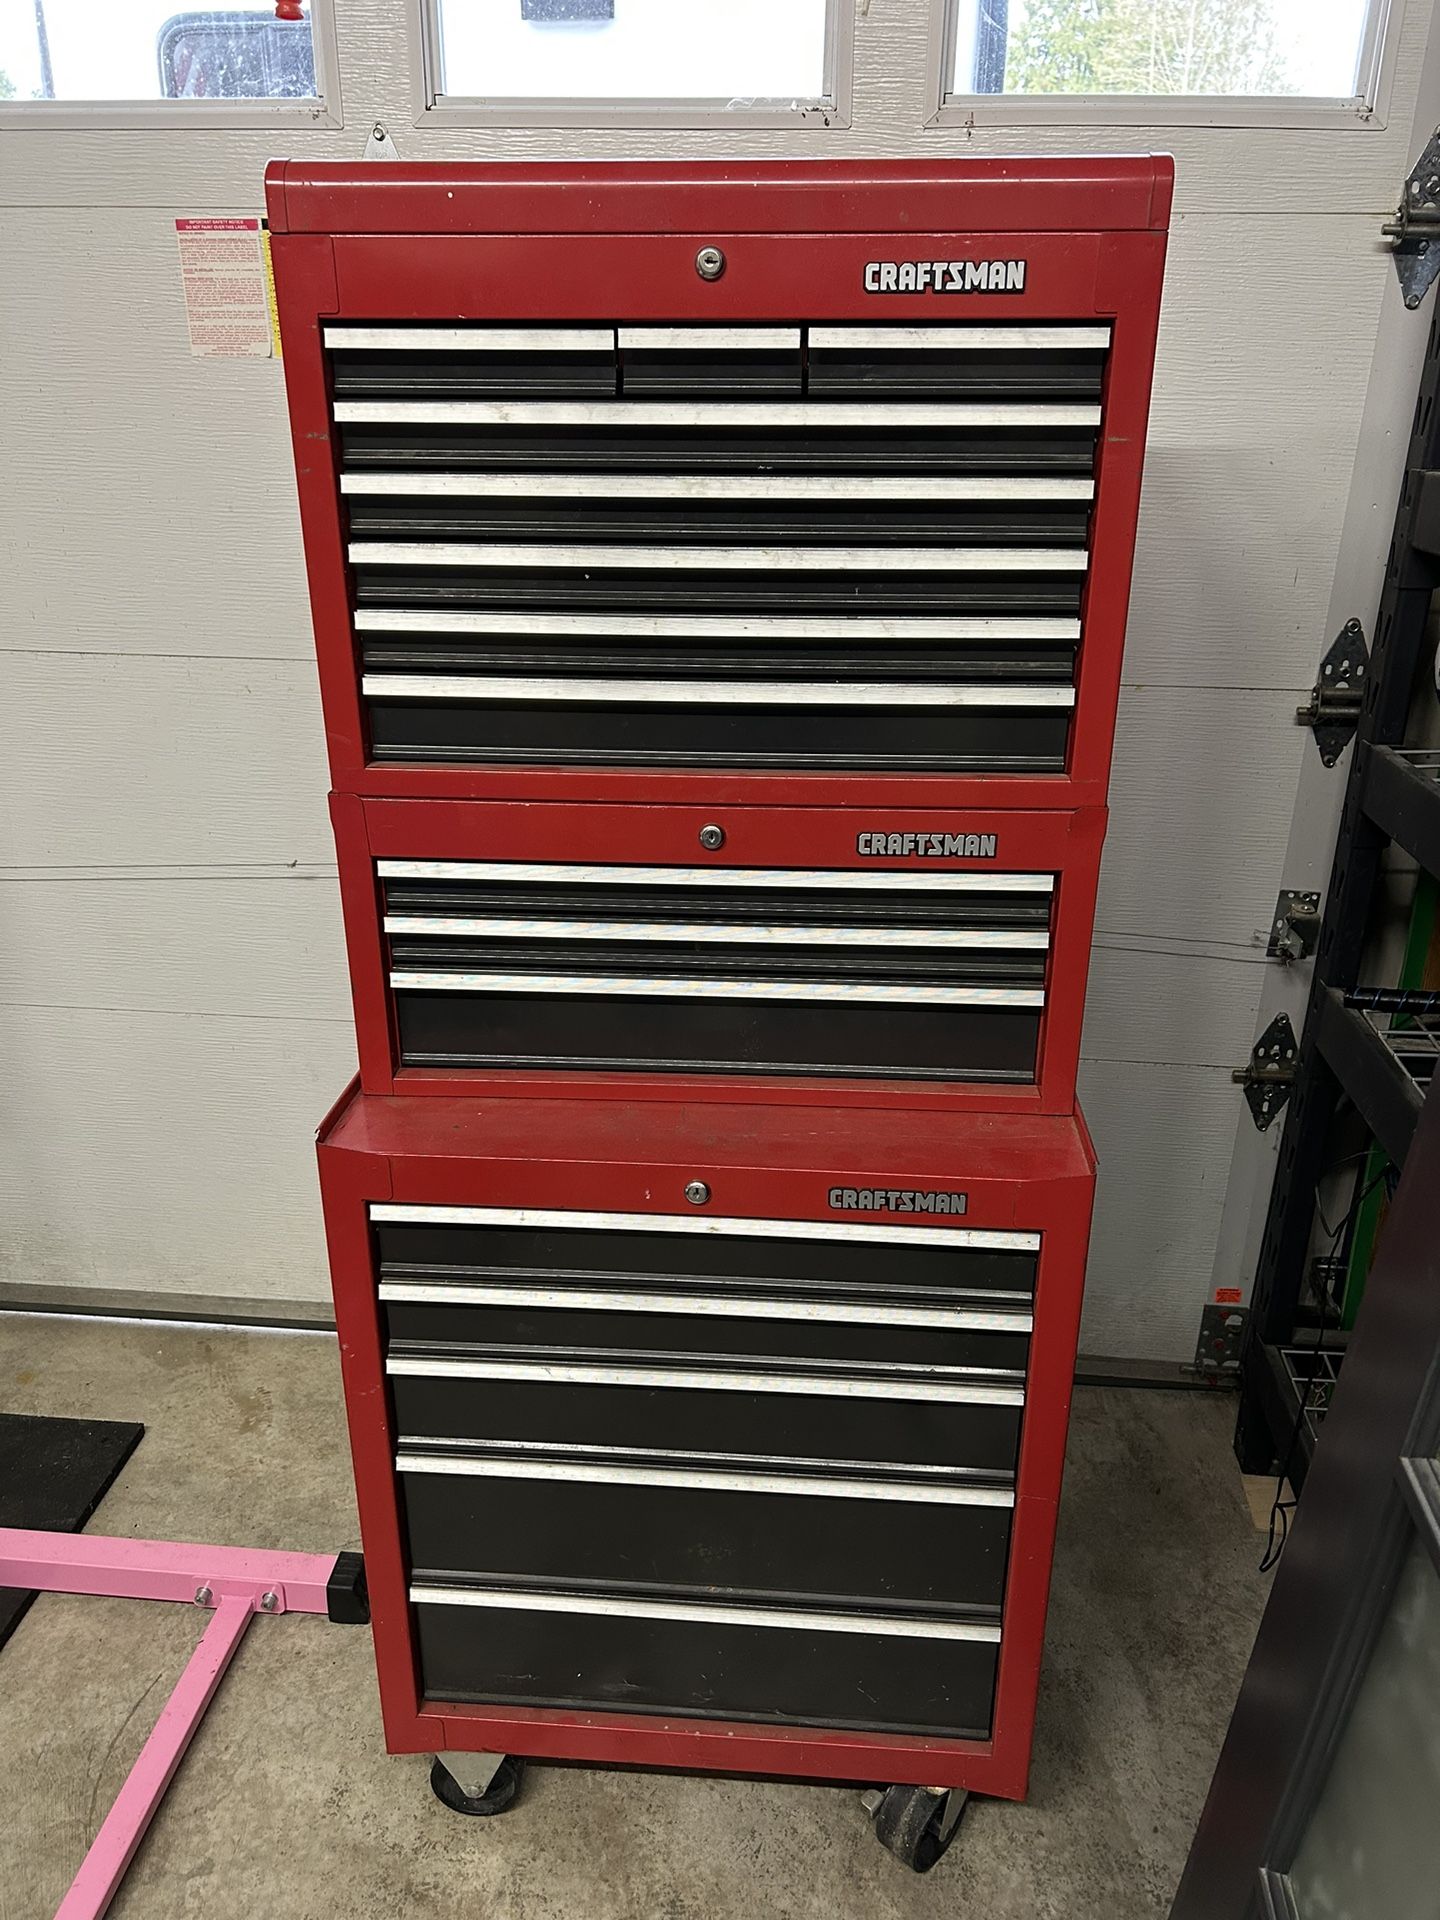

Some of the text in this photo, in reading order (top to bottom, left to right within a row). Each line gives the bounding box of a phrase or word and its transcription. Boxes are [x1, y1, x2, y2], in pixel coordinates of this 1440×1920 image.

[864, 260, 1026, 293] CRAFTSMAN
[857, 832, 997, 857] CRAFTSMAN
[829, 1188, 967, 1215] CRAFTSMAN
